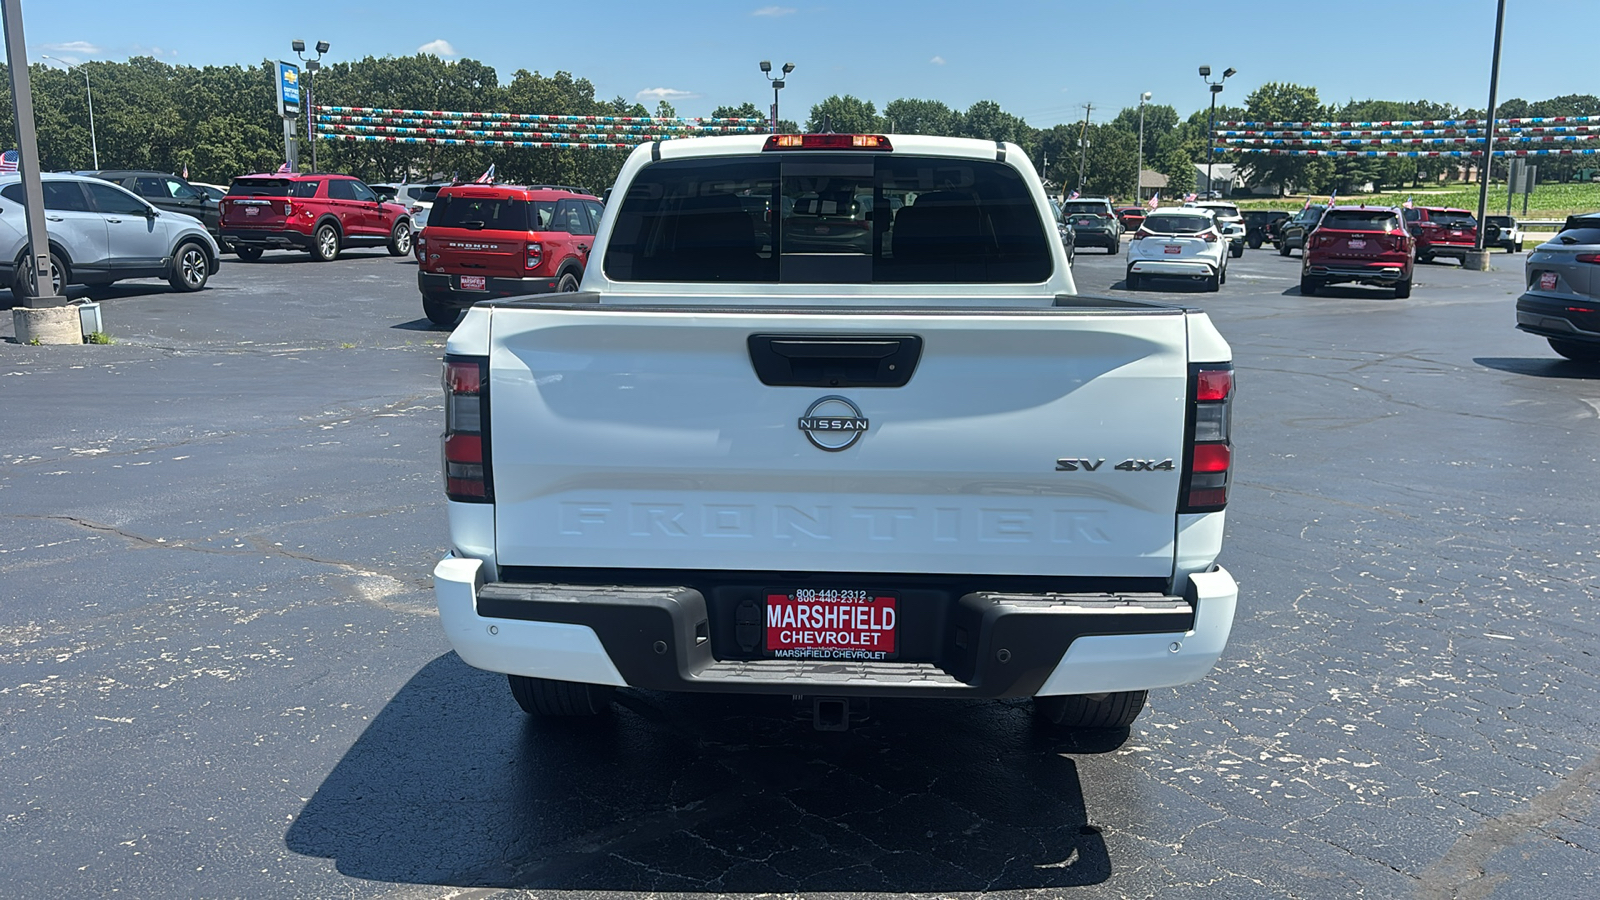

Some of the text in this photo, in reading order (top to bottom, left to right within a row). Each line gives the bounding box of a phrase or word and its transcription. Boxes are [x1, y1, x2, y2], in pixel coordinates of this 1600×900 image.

[800, 419, 867, 430] NISSAN
[1055, 458, 1105, 471] SV
[558, 500, 1112, 545] FRONTIER
[796, 589, 867, 599] 800-440-2312
[767, 604, 896, 630] MARSHFIELD
[780, 630, 881, 645] CHEVROLET
[775, 649, 886, 659] MARSHFIELD CHEVROLET
